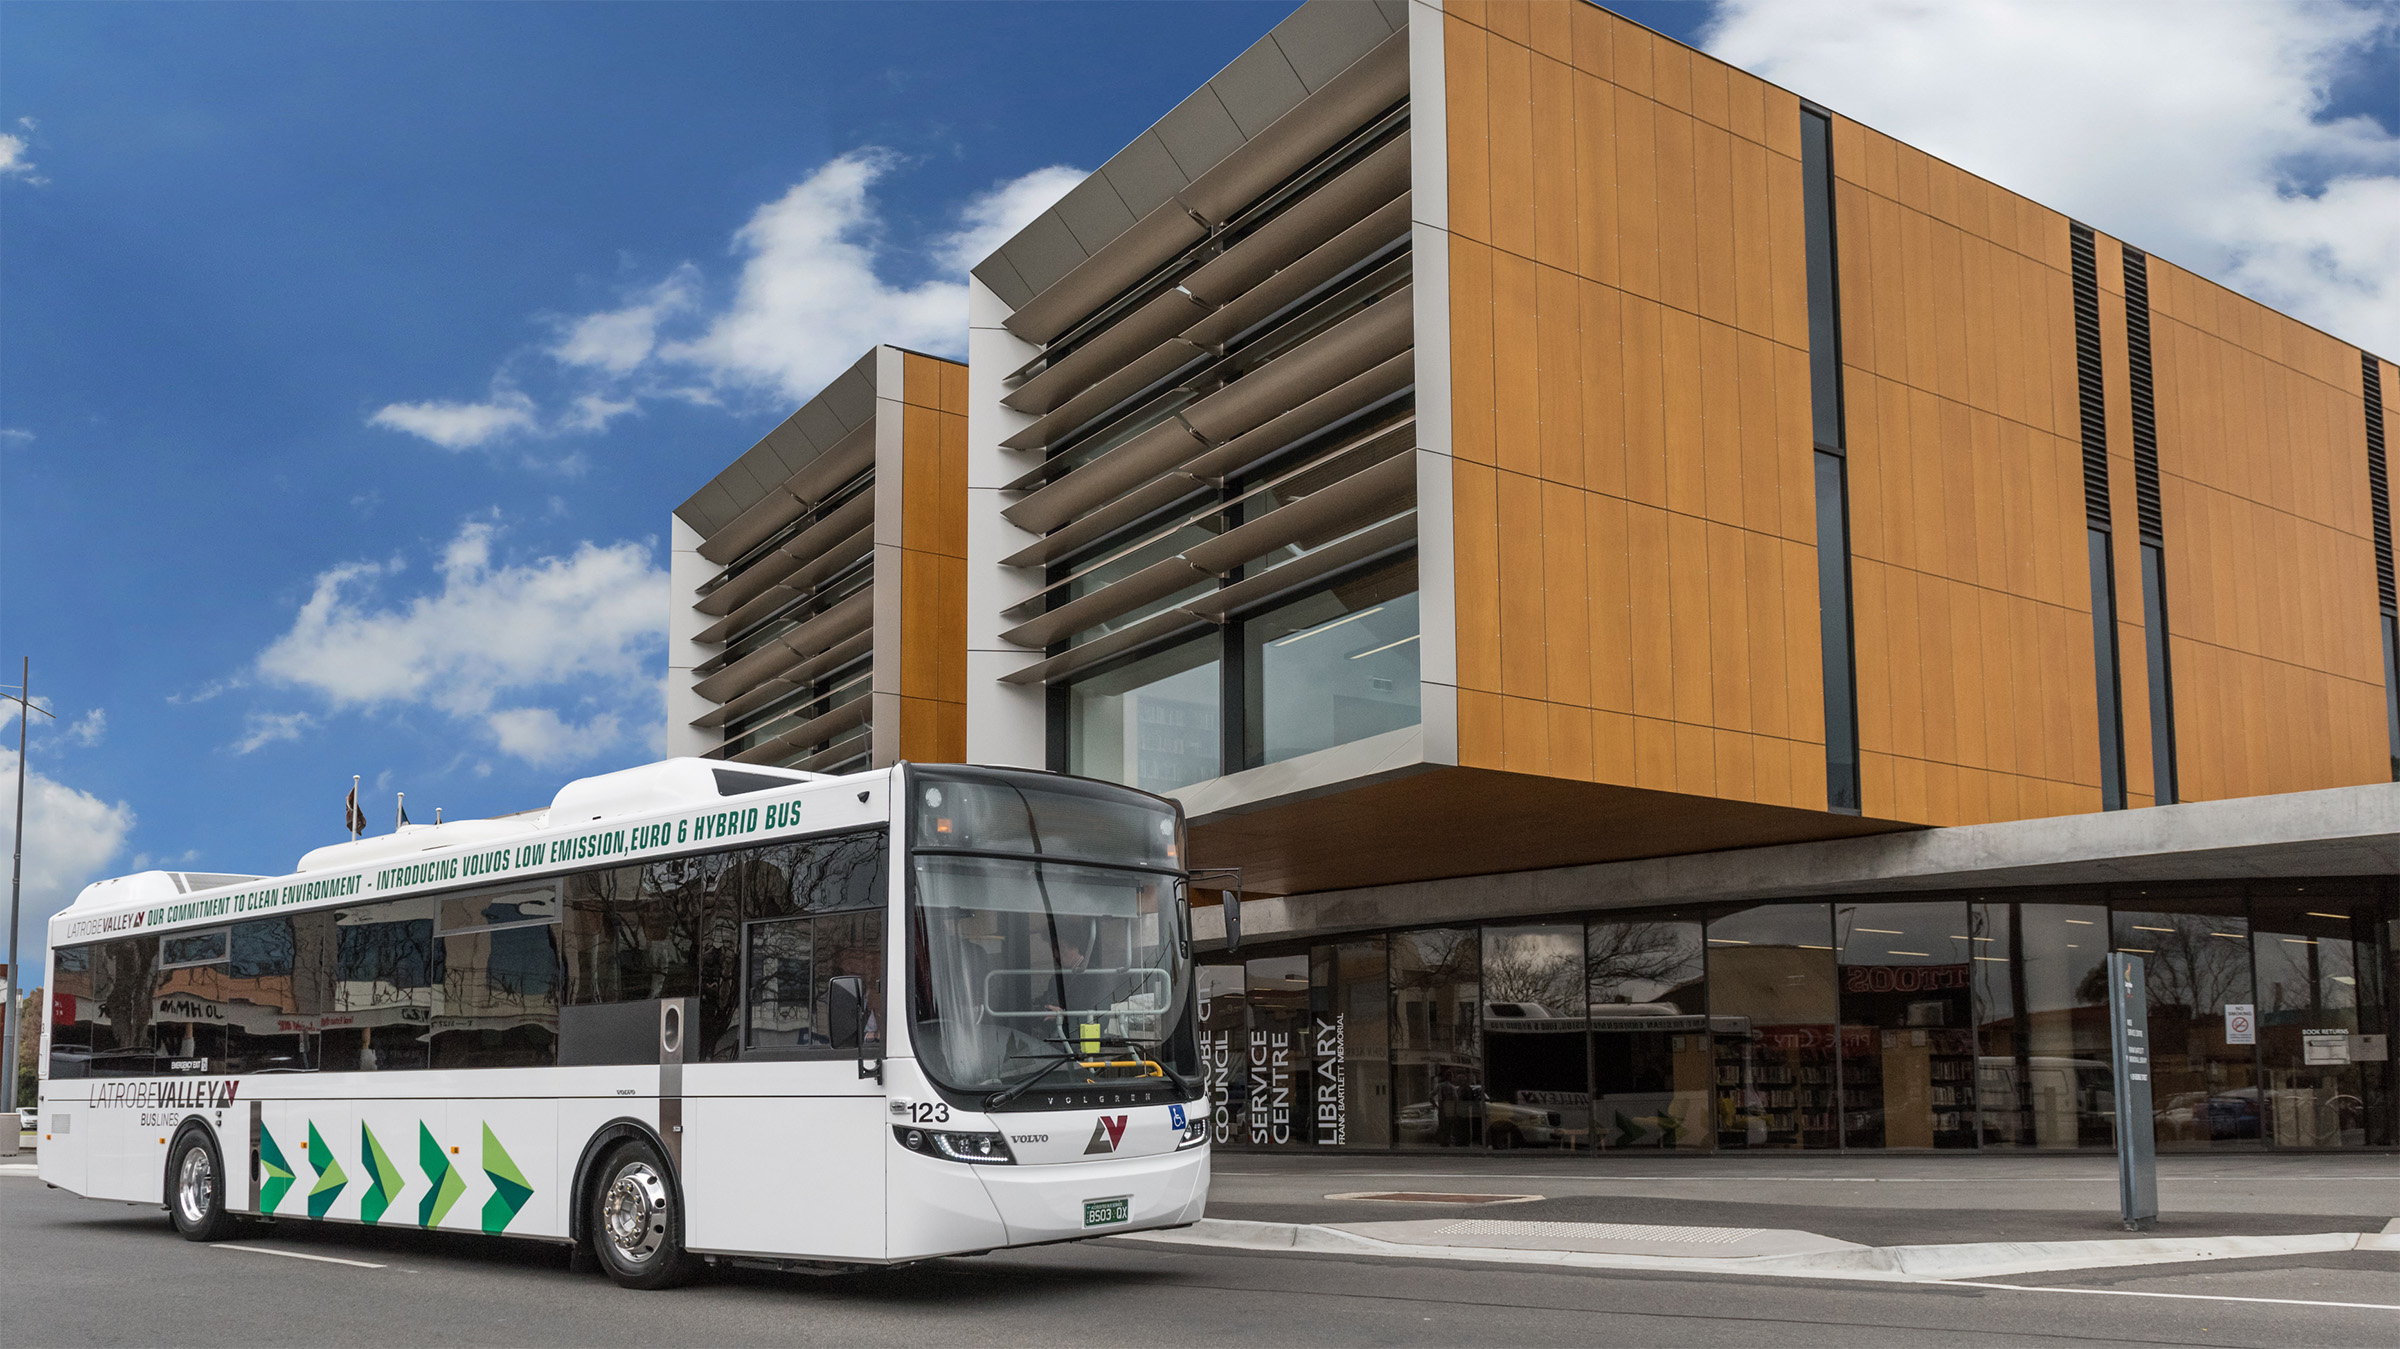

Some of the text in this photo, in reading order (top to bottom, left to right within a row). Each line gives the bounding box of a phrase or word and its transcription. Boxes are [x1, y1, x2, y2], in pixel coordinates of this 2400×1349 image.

[147, 908, 164, 926] OUR
[167, 897, 231, 923] COMMITMENT
[234, 894, 246, 913] TO
[247, 888, 279, 910] CLEAN
[282, 875, 362, 905] ENVIRONMENT
[376, 858, 458, 891] INTRODUCING
[462, 849, 511, 877] VOLVOS
[515, 843, 546, 869] LOW
[677, 819, 687, 843] 6
[693, 807, 758, 841] HYBRID
[765, 800, 802, 830] BUS
[140, 1112, 180, 1127] BUSLINES
[906, 1102, 950, 1124] 123
[1047, 1092, 1151, 1105] VOLGREN
[1215, 1030, 1229, 1144] COUNCIL
[1251, 1030, 1268, 1144] SERVICE
[1272, 1031, 1290, 1145] CENTRE
[1316, 1017, 1338, 1145] LIBRARY
[1336, 1012, 1346, 1145] FRANK BARTLETT MEMORIAL
[1011, 1133, 1049, 1144] VOLVO
[1116, 1206, 1128, 1220] QX
